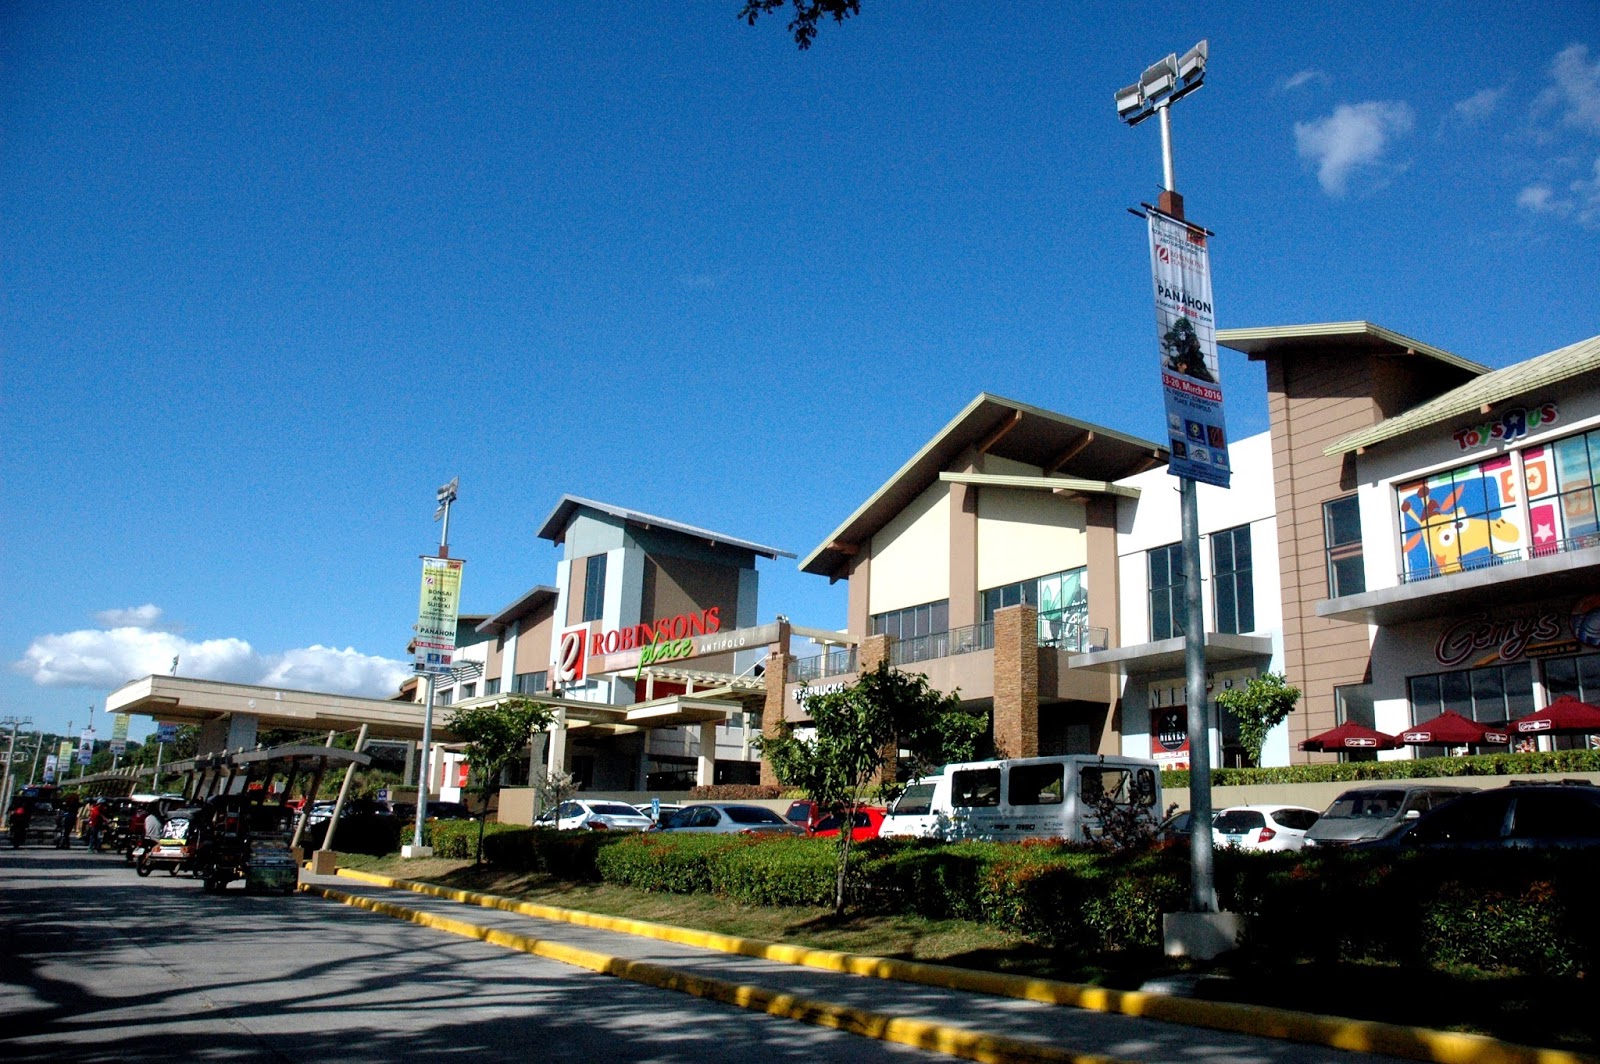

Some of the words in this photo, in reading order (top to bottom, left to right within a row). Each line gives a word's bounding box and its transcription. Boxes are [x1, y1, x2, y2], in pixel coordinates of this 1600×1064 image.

[1157, 284, 1212, 314] PANAHON
[1182, 381, 1204, 396] March
[1203, 388, 1222, 401] 2016
[428, 588, 452, 597] BONSAI
[420, 627, 455, 637] PANAHON
[591, 606, 721, 657] ROBINSONS
[700, 636, 746, 653] ANTIPOLO
[634, 631, 695, 682] place
